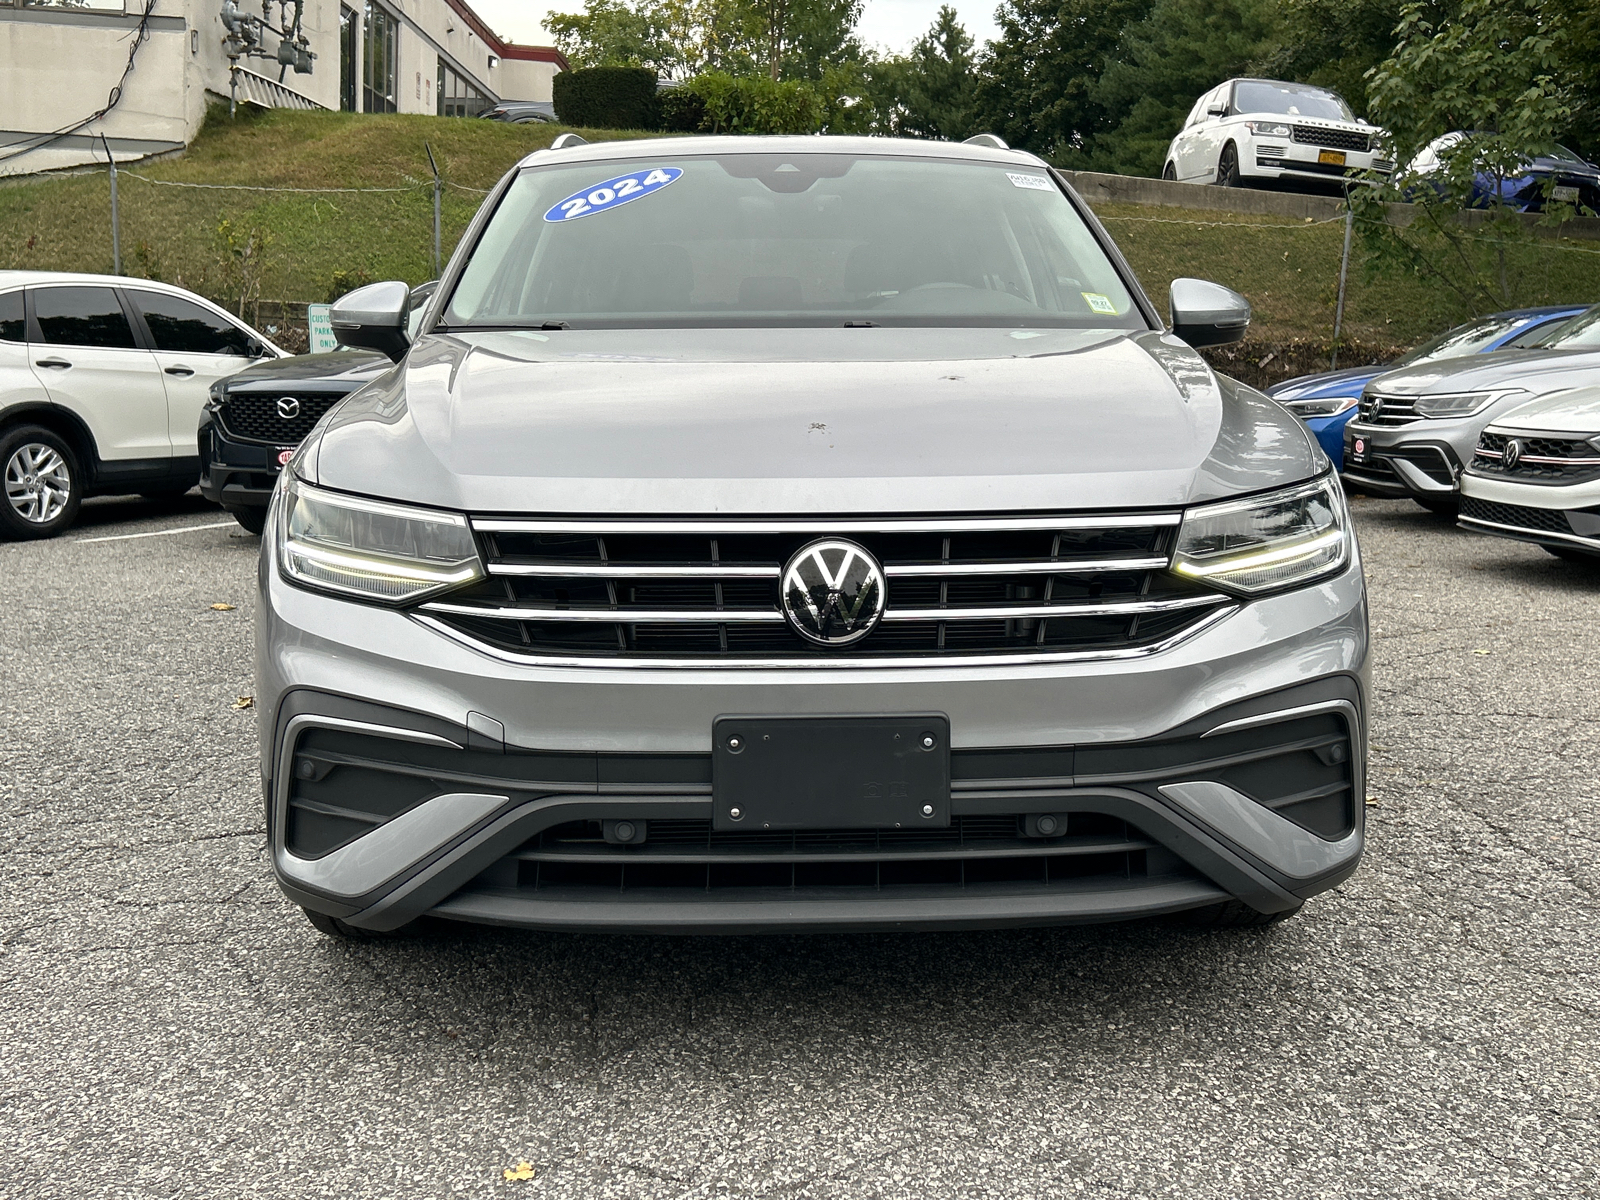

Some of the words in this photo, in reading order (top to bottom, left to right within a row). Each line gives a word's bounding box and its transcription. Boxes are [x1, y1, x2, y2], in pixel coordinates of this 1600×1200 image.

[1297, 119, 1329, 127] RANGE
[1335, 124, 1366, 132] ROVER
[560, 169, 672, 219] 2024
[319, 339, 336, 348] ONLY
